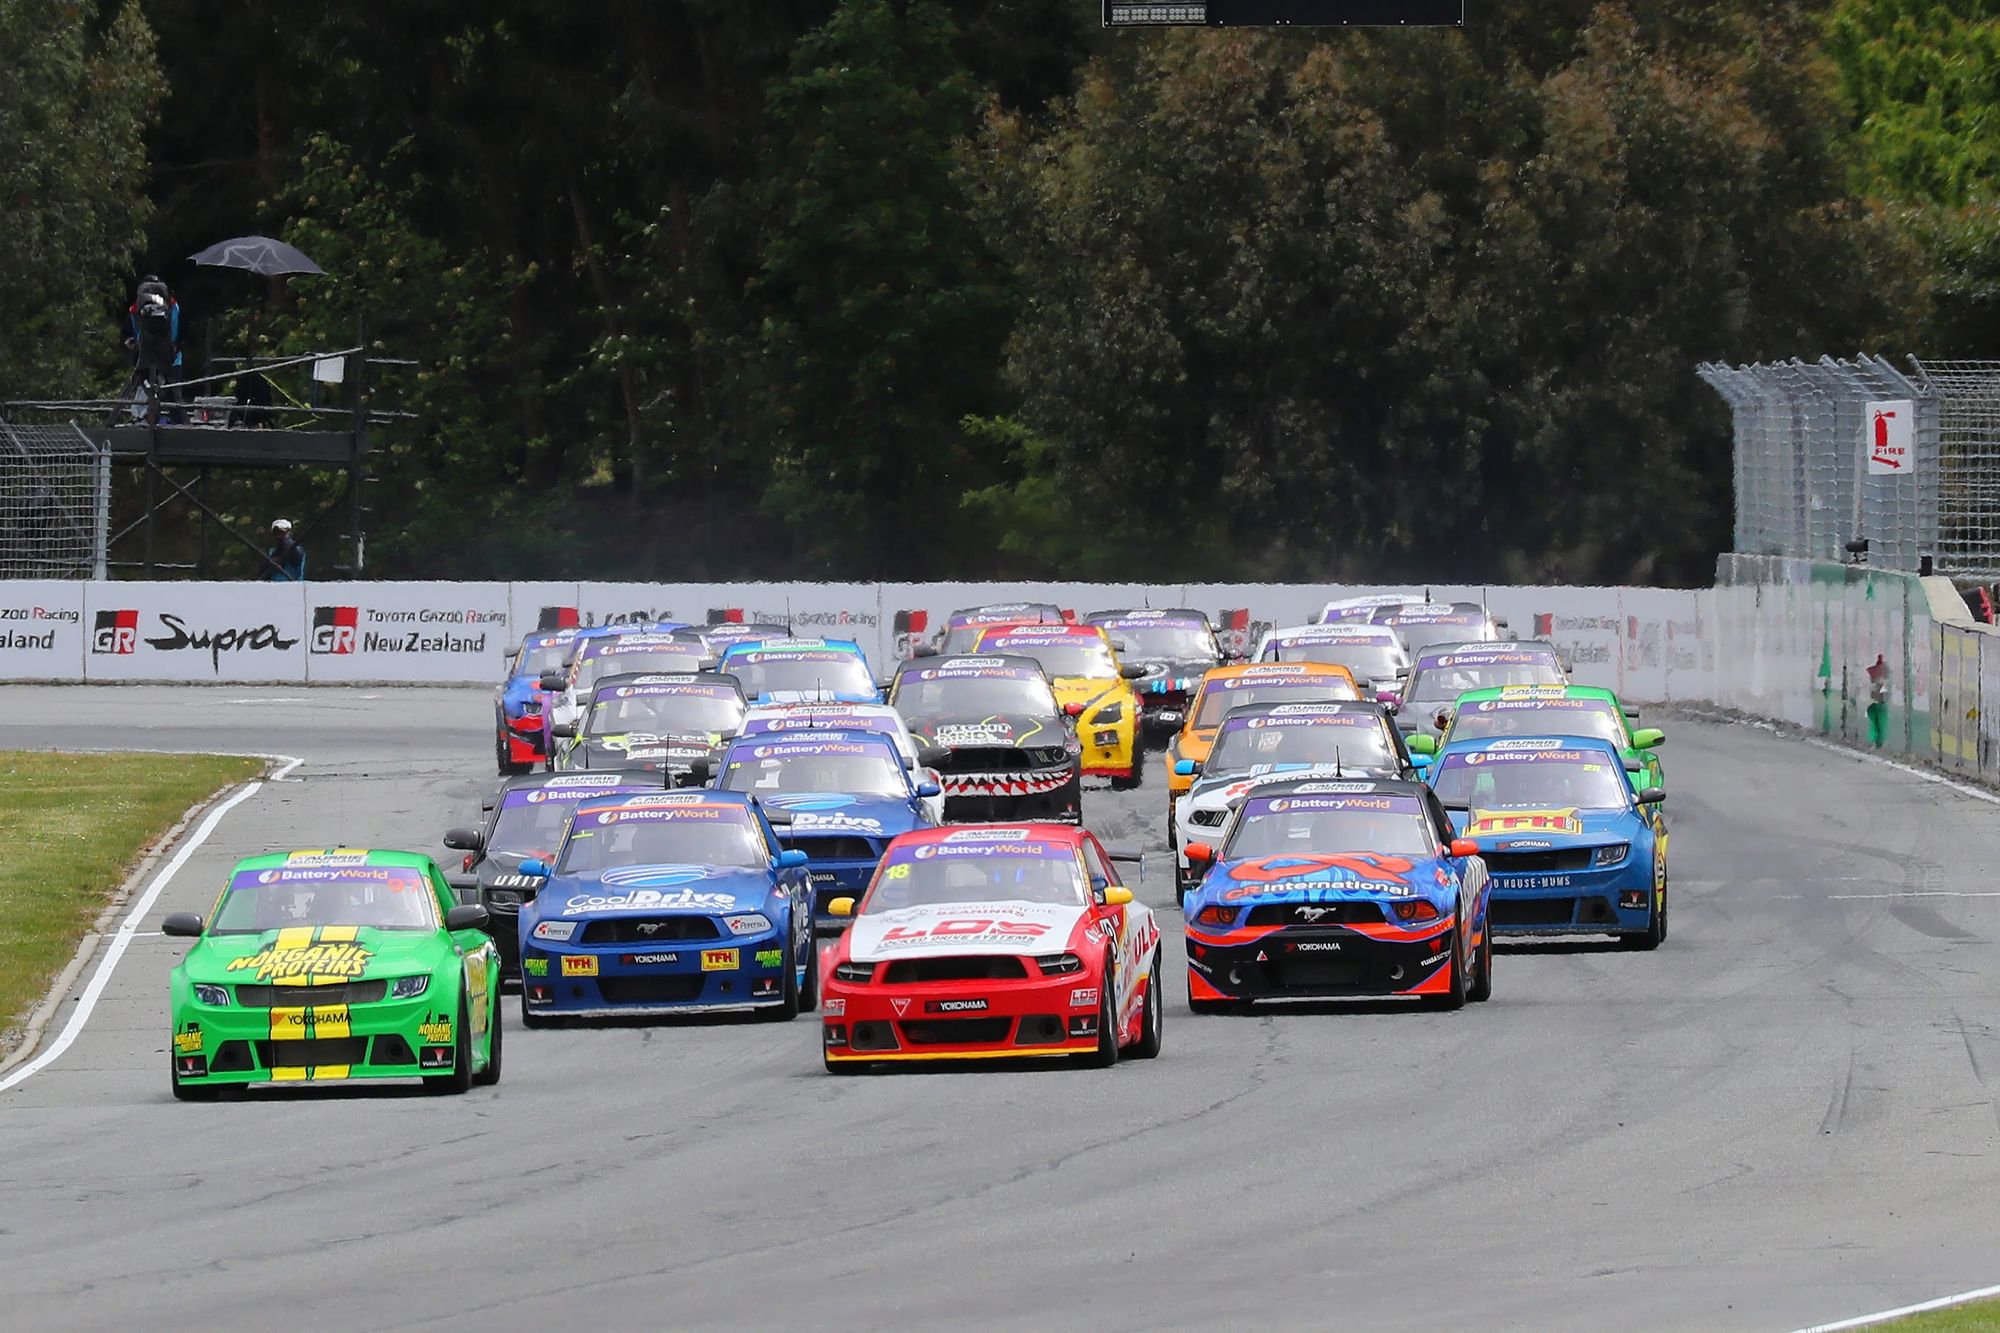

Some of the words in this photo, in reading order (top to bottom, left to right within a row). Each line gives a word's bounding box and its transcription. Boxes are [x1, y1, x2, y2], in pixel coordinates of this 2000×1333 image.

[1874, 447, 1905, 455] FIRE
[0, 608, 29, 620] ZOO
[32, 606, 79, 624] Racing
[366, 609, 416, 623] TOYOTA
[419, 609, 463, 624] GAZOO
[465, 609, 506, 627] Racing
[0, 629, 55, 649] aland
[144, 613, 300, 675] Supra
[1454, 654, 1533, 663] BatteryWorld
[937, 669, 1016, 678] BatteryWorld
[1242, 676, 1323, 686] BatteryWorld
[634, 686, 715, 696] BatteryWorld
[1496, 700, 1584, 709] BatteryWorld
[785, 719, 873, 729] BatteryWorld
[1266, 717, 1354, 726] BatteryWorld
[774, 743, 865, 755] BatteryWorld
[1486, 751, 1581, 761] BatteryWorld
[1290, 798, 1392, 809] BatteryWorld
[619, 809, 720, 822] BatteryWorld
[791, 811, 881, 828] Drive
[1474, 815, 1566, 831] TFH
[937, 844, 1043, 856] BatteryWorld
[281, 870, 389, 880] BatteryWorld
[886, 863, 911, 880] 18
[493, 875, 543, 887] UNIT
[1503, 878, 1536, 889] HOUSE
[1225, 885, 1263, 900] CR
[1262, 881, 1410, 897] International
[566, 888, 737, 909] CoolDrive
[882, 919, 1054, 941] LDS
[1297, 942, 1341, 951] YOKOHAMA
[225, 944, 374, 971] NORGANIC
[565, 957, 591, 969] TFH
[634, 953, 678, 963] YOKOHAMA
[706, 951, 733, 963] TFH
[255, 959, 366, 982] PROTEINS
[1072, 990, 1097, 1000] LDS
[940, 1000, 988, 1011] YOKOHAMA
[287, 1013, 353, 1026] YOKOHAMA
